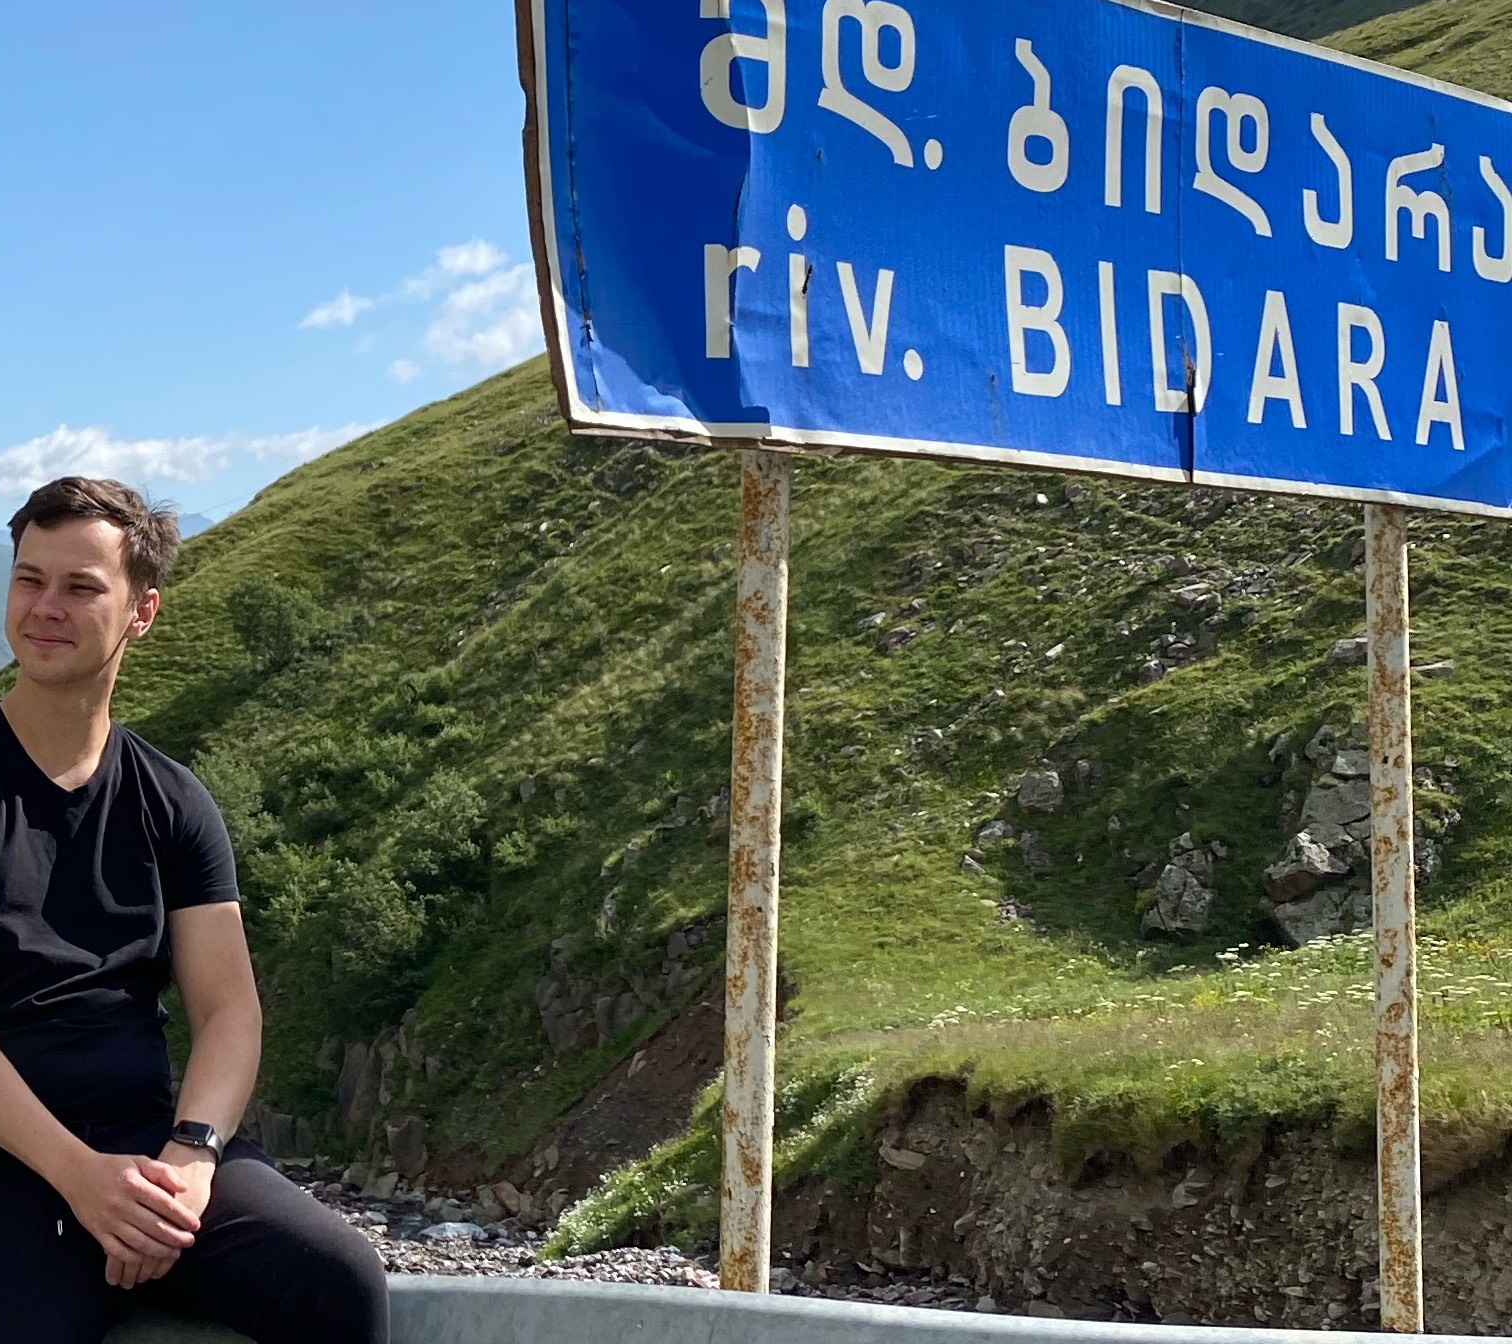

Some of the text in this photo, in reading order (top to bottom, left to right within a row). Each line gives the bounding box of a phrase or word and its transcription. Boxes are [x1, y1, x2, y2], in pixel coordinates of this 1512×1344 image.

[1006, 38, 1512, 283] ბიდარა
[703, 203, 1466, 451] riv. BIDARA
